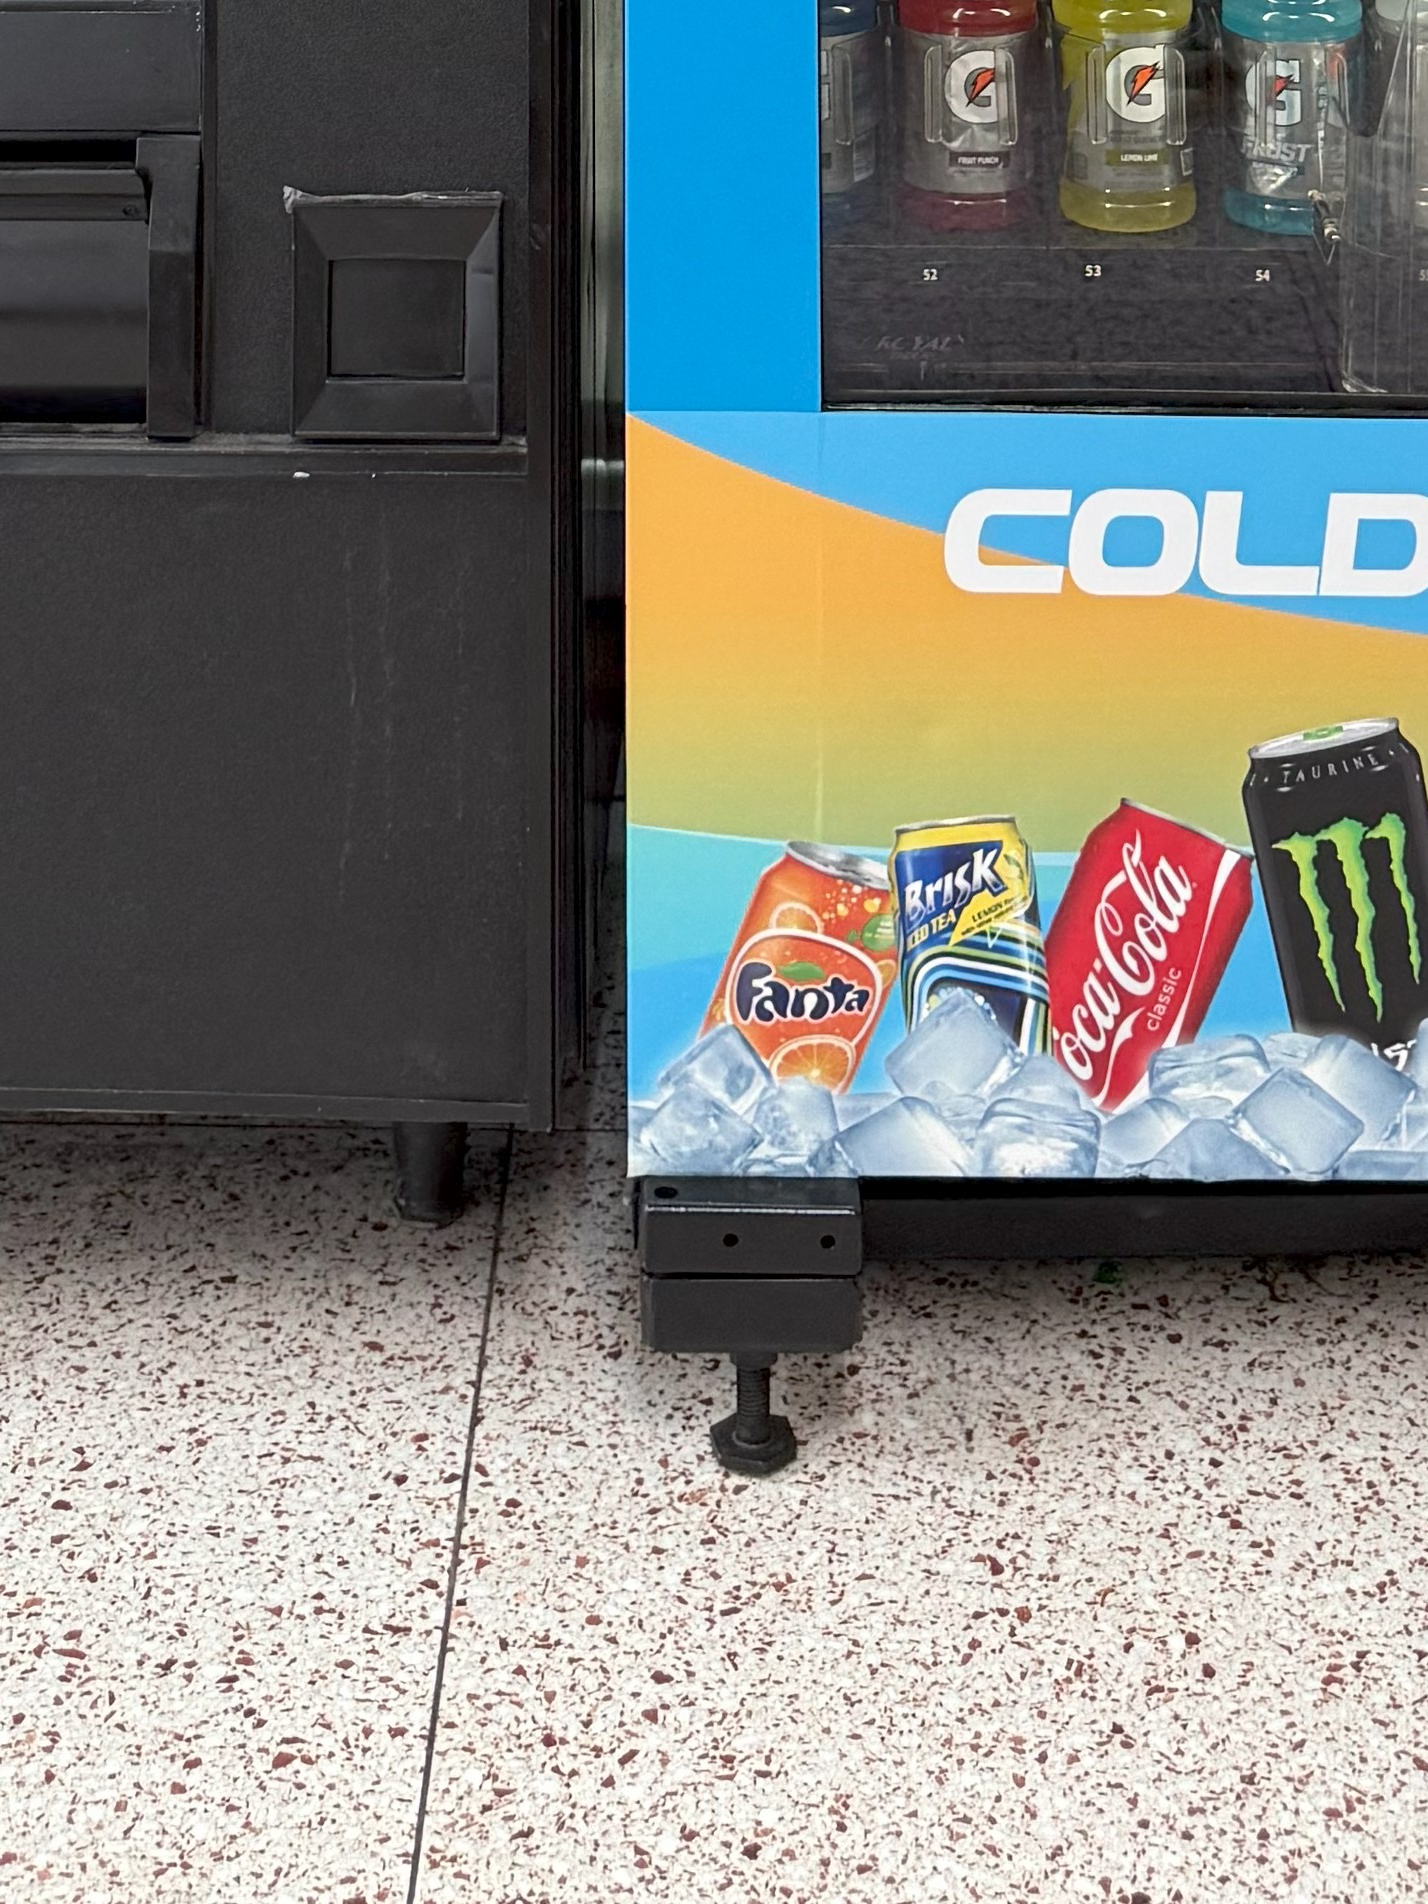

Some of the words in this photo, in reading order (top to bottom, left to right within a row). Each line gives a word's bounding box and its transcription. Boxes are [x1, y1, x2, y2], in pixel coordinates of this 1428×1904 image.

[923, 269, 938, 281] 52
[1255, 269, 1270, 281] 54
[1281, 753, 1377, 784] TAURINE
[905, 847, 1003, 919] Brisk
[739, 962, 869, 1021] Fanta
[1147, 968, 1183, 1032] classic
